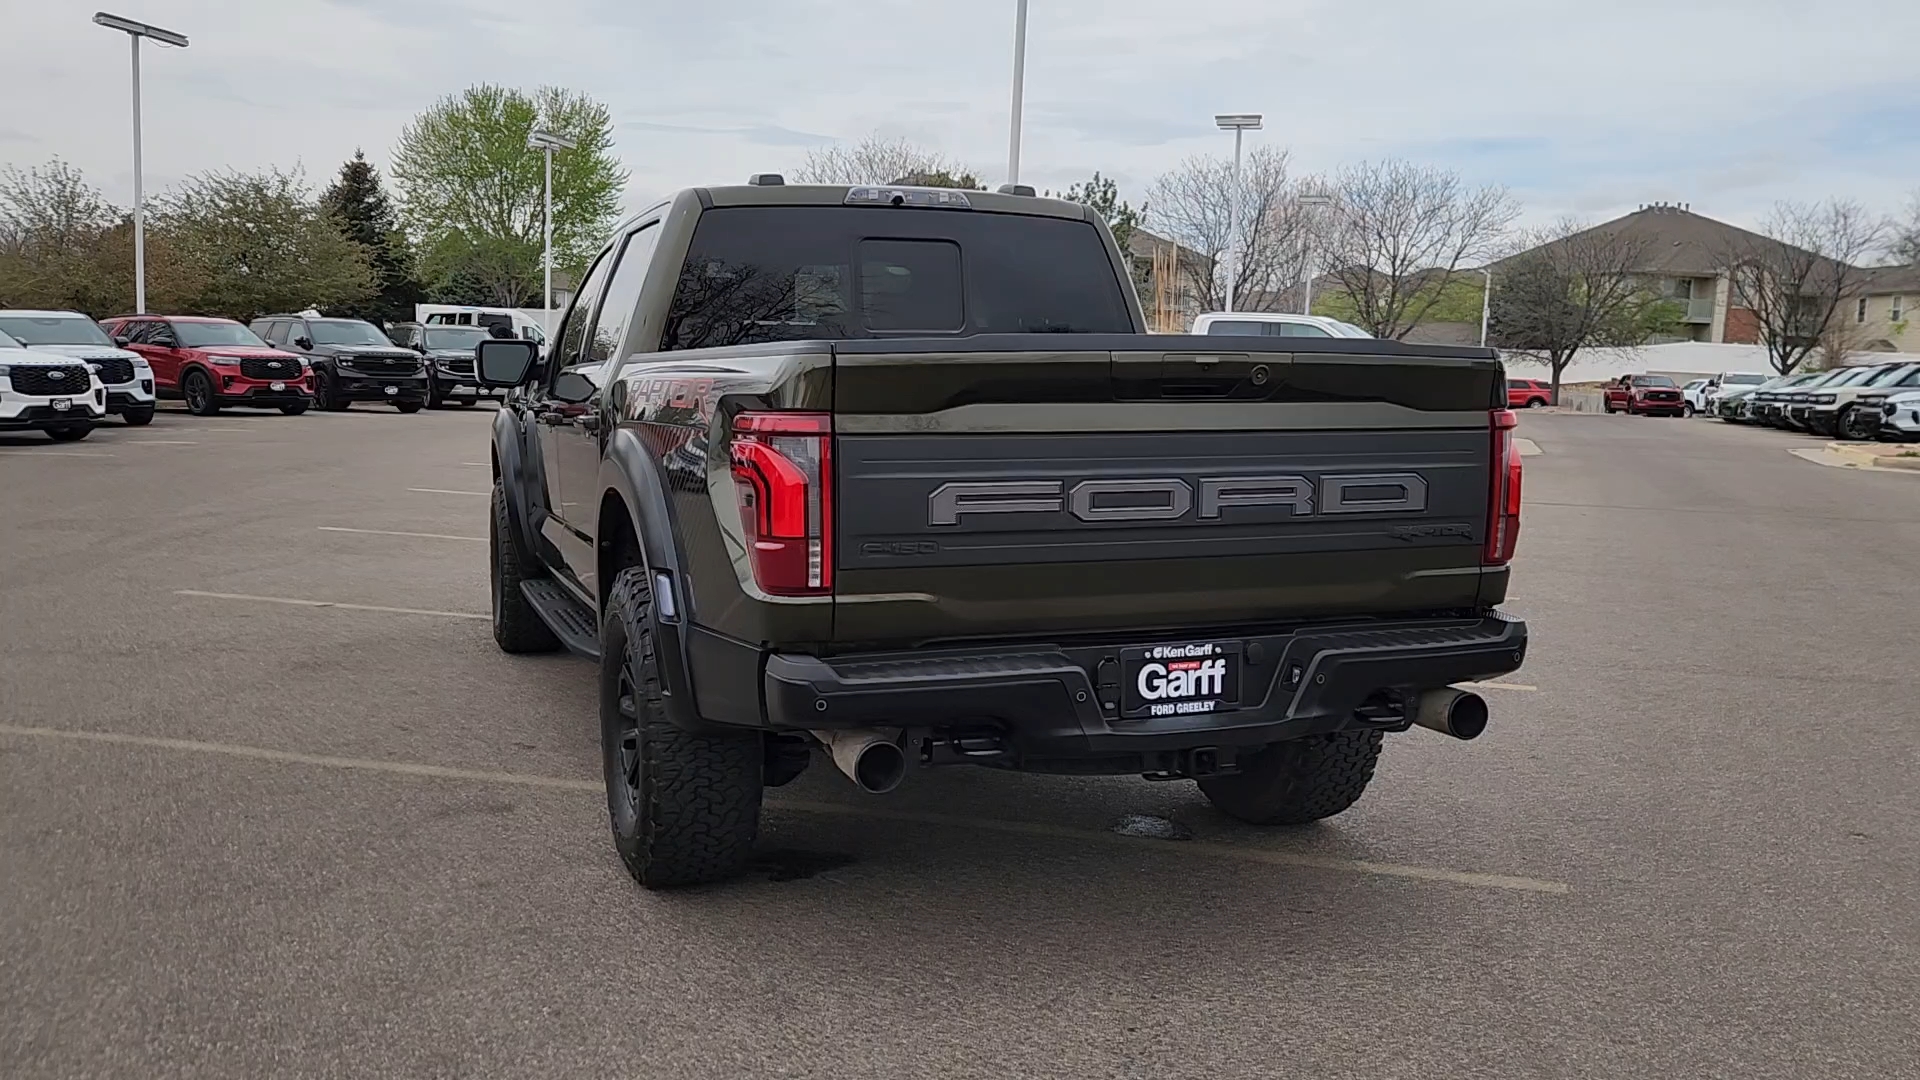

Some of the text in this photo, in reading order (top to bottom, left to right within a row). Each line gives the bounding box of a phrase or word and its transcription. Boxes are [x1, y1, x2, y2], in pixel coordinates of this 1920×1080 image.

[927, 474, 1428, 526] FORD
[1163, 644, 1213, 658] Ken Garff
[1138, 659, 1226, 700] Garff
[1151, 701, 1215, 716] FORD GREELEY
